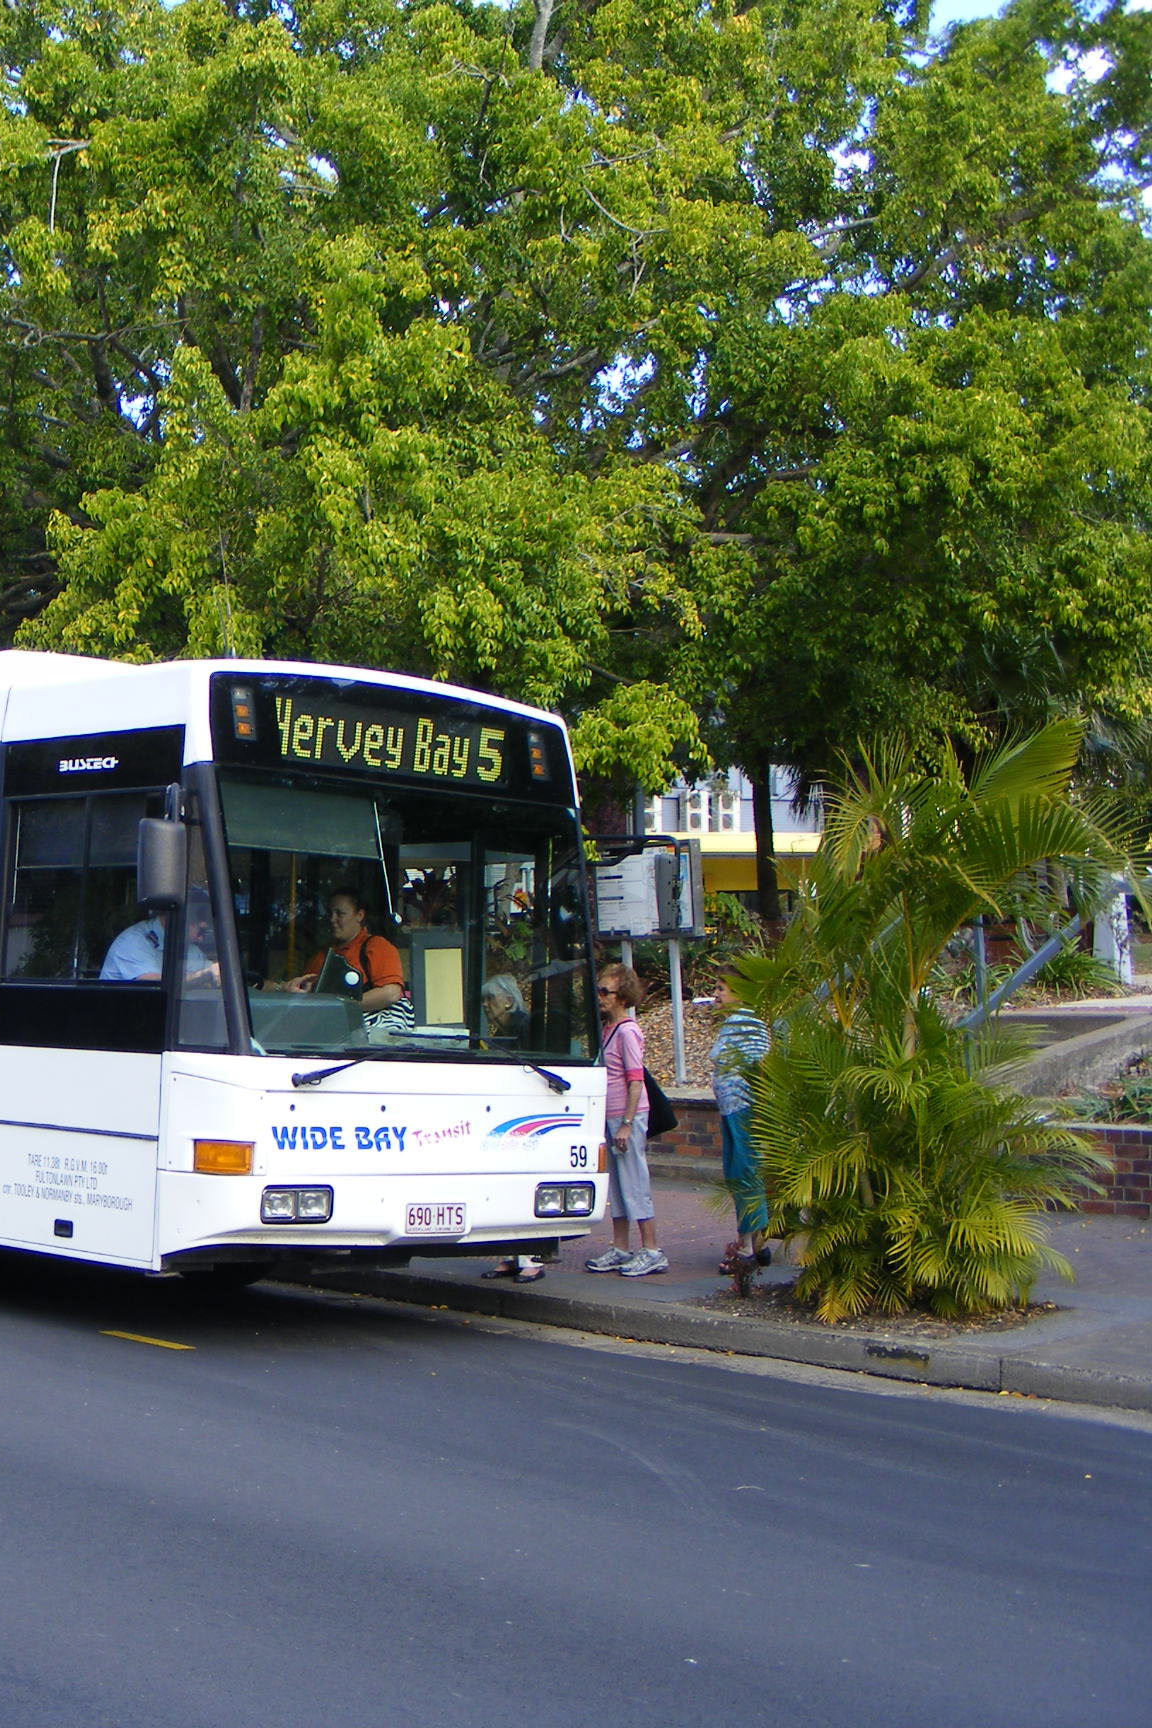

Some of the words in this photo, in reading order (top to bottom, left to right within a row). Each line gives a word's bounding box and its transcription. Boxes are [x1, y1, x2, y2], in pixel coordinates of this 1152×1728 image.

[413, 717, 470, 778] Bay
[477, 727, 506, 782] 5
[272, 1126, 345, 1150] WIDE
[355, 1126, 407, 1152] BAY
[412, 1120, 471, 1147] Transit
[570, 1145, 587, 1168] 59
